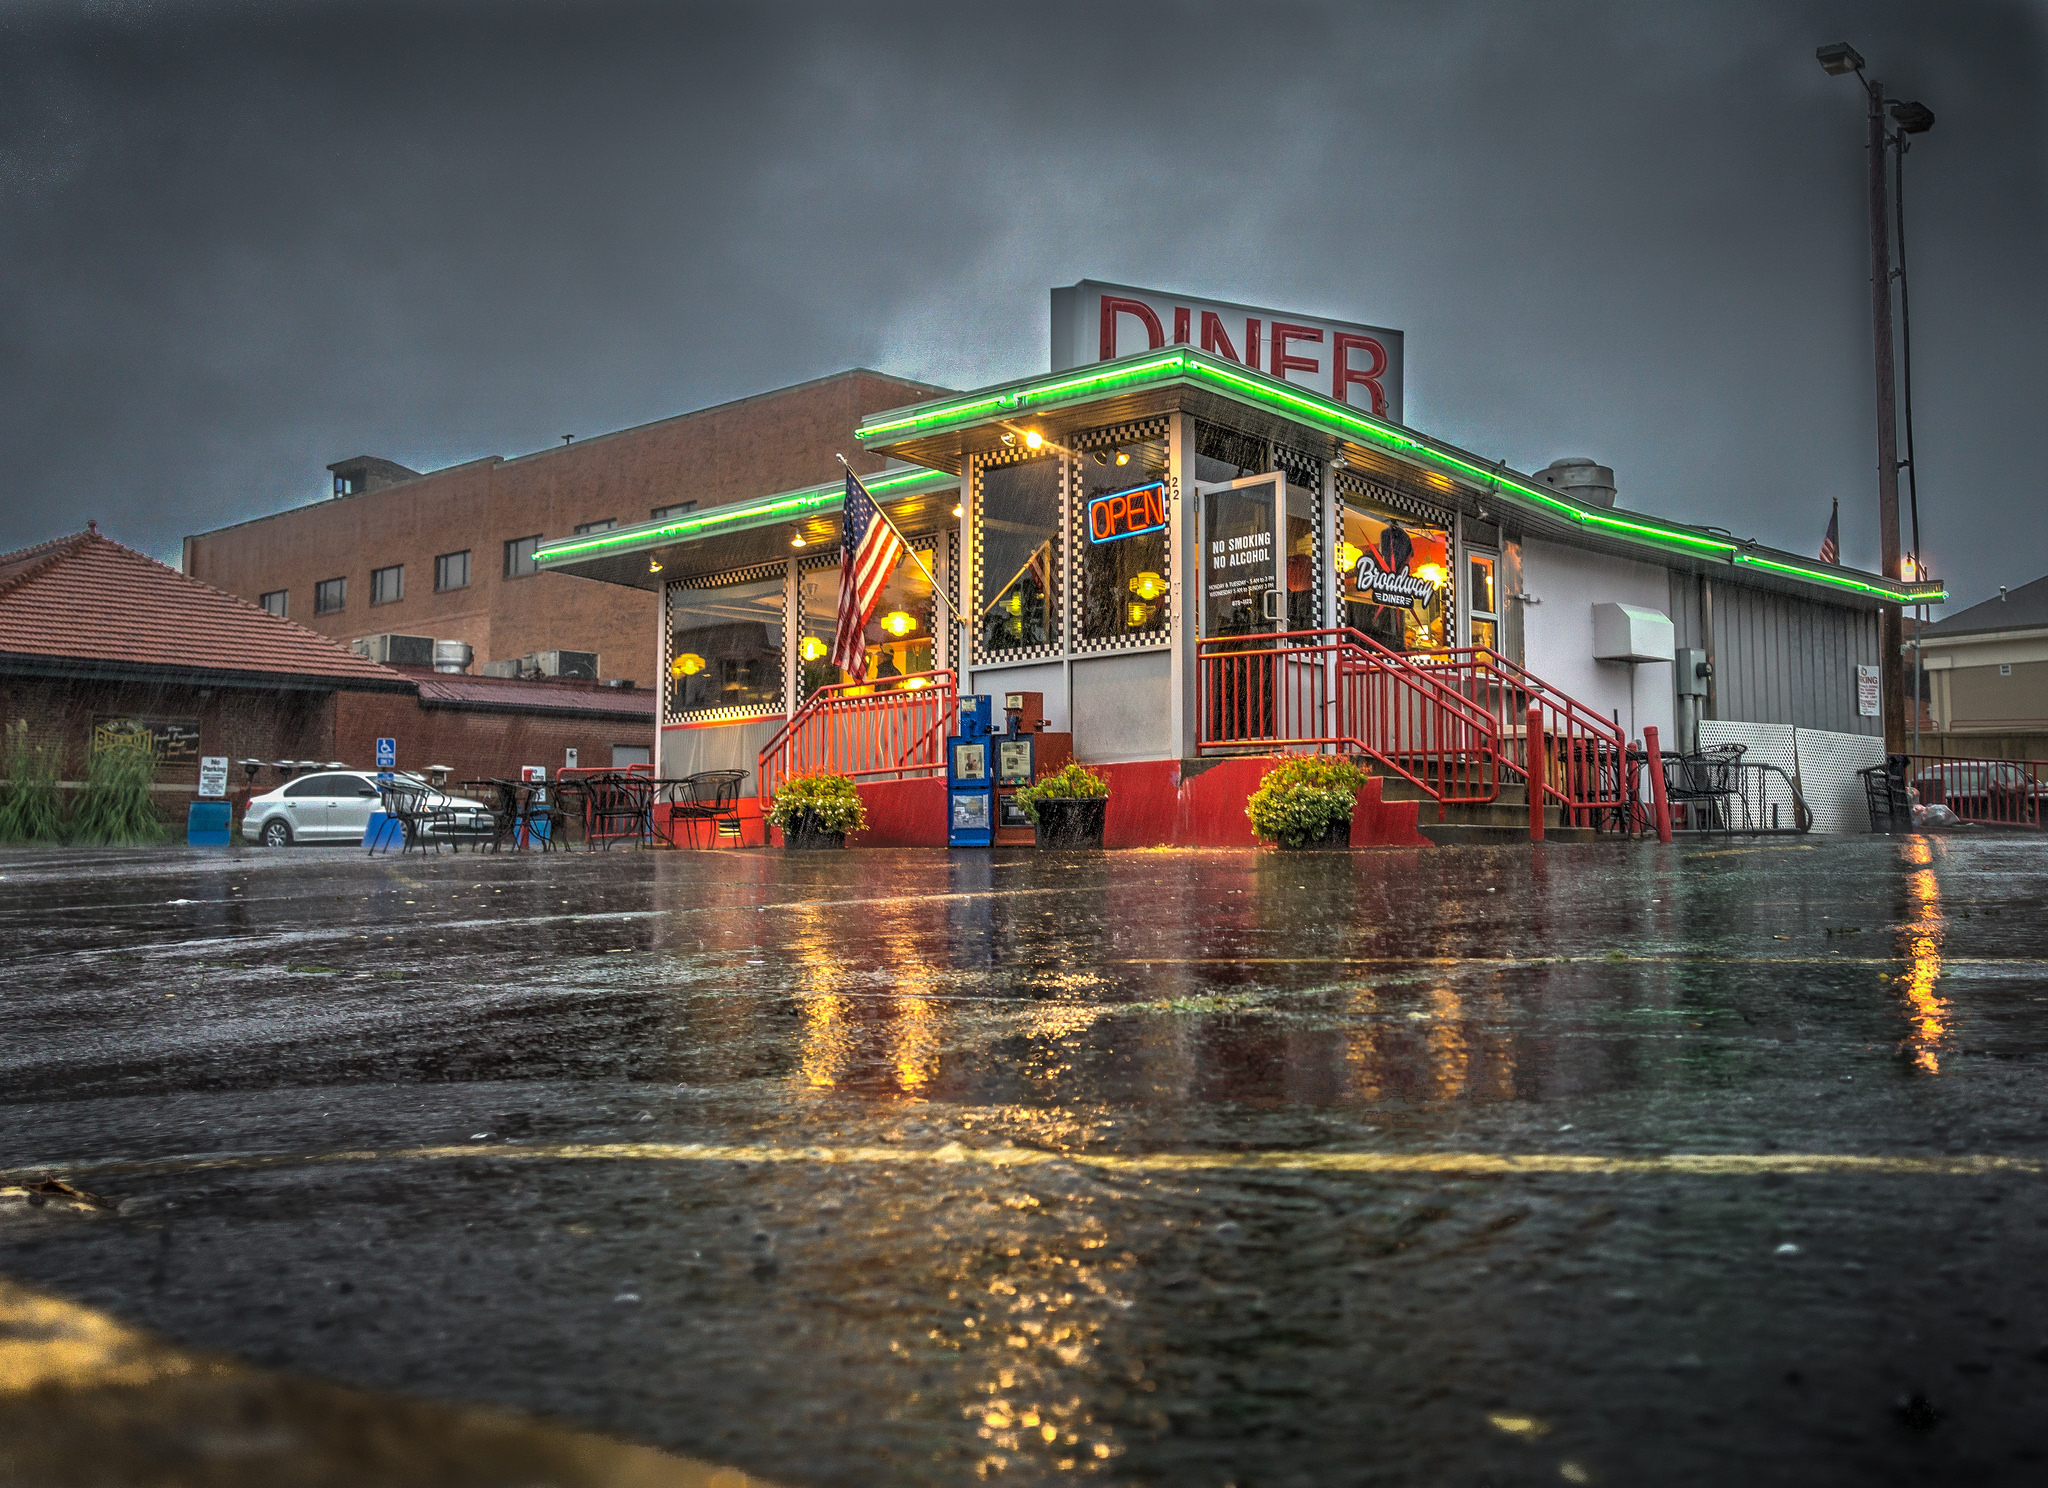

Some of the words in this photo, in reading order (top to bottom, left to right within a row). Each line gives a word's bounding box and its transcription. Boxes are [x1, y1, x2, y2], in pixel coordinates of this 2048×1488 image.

[1091, 486, 1164, 539] OPEN
[1212, 540, 1225, 554] NO
[1228, 532, 1271, 551] SMOKING
[1213, 555, 1226, 569] NO
[1229, 548, 1270, 566] ALCOHOL
[1357, 556, 1435, 607] Broadway
[1382, 593, 1405, 605] DINER
[1859, 675, 1878, 684] KING
[202, 765, 226, 773] Parking
